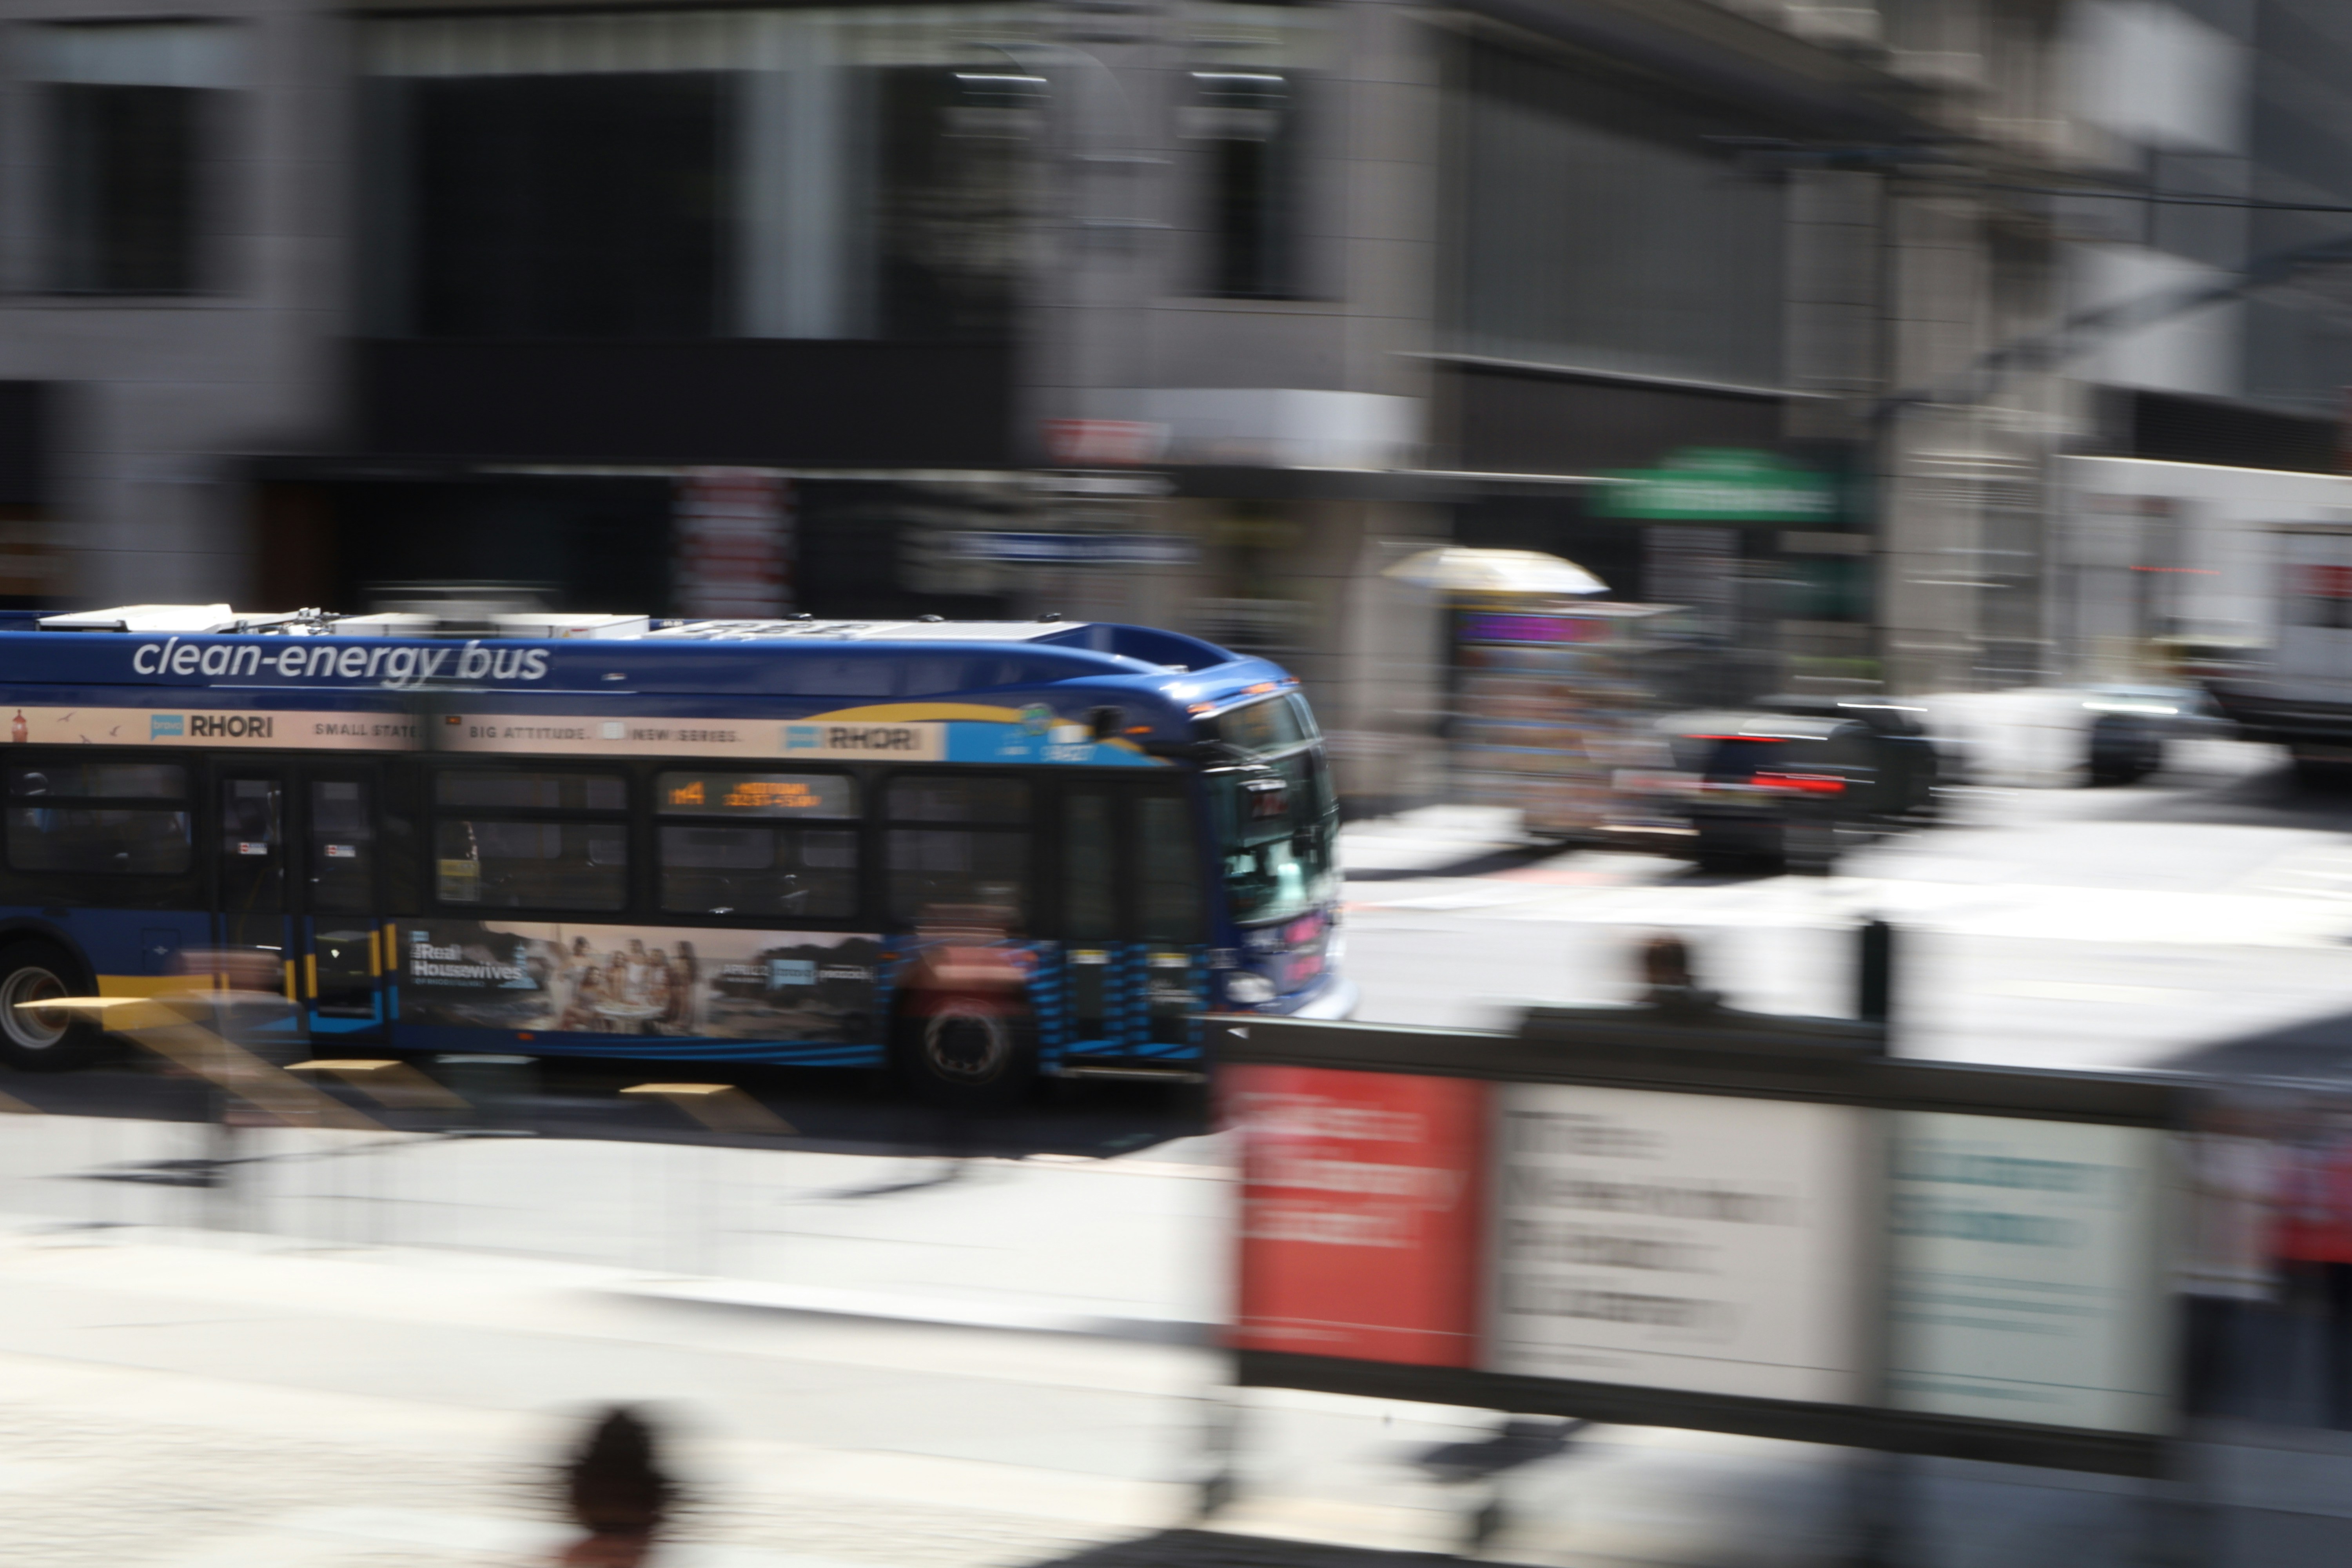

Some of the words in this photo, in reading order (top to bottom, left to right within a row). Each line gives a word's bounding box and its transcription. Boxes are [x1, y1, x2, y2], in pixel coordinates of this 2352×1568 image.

[133, 637, 452, 688] clean-energy
[455, 640, 550, 680] bus
[191, 715, 273, 738] RHORI
[314, 723, 367, 736] SMALL
[470, 726, 497, 739] BIG
[630, 729, 669, 740] NEW
[828, 726, 921, 751] RHORI
[421, 943, 462, 960] Real
[410, 960, 523, 980] Housewives
